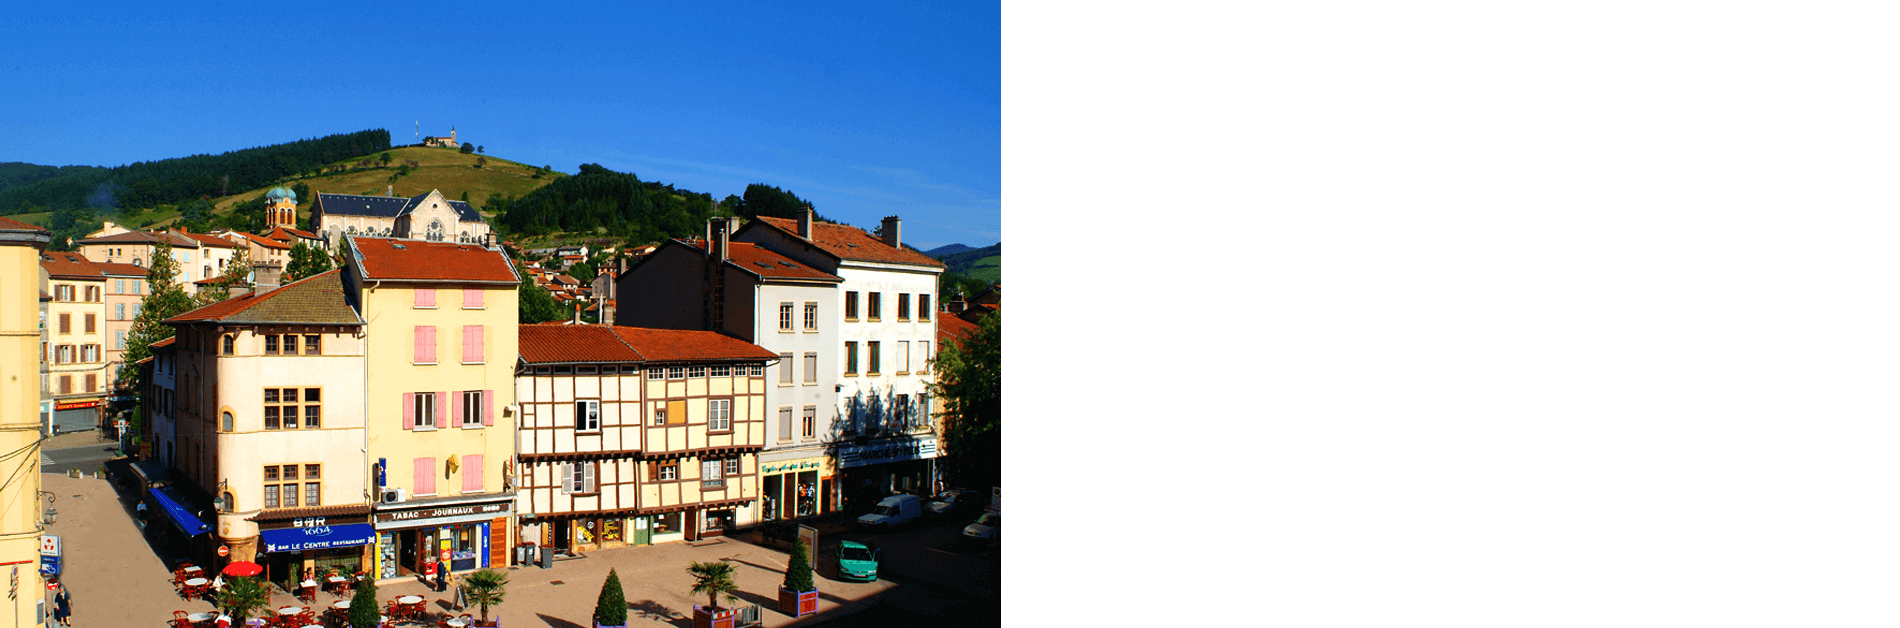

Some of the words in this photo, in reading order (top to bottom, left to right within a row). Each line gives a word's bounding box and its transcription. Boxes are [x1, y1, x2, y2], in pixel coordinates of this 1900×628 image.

[432, 507, 474, 516] JOURNAUX
[293, 517, 325, 527] BAR
[303, 541, 330, 549] CENTRE
